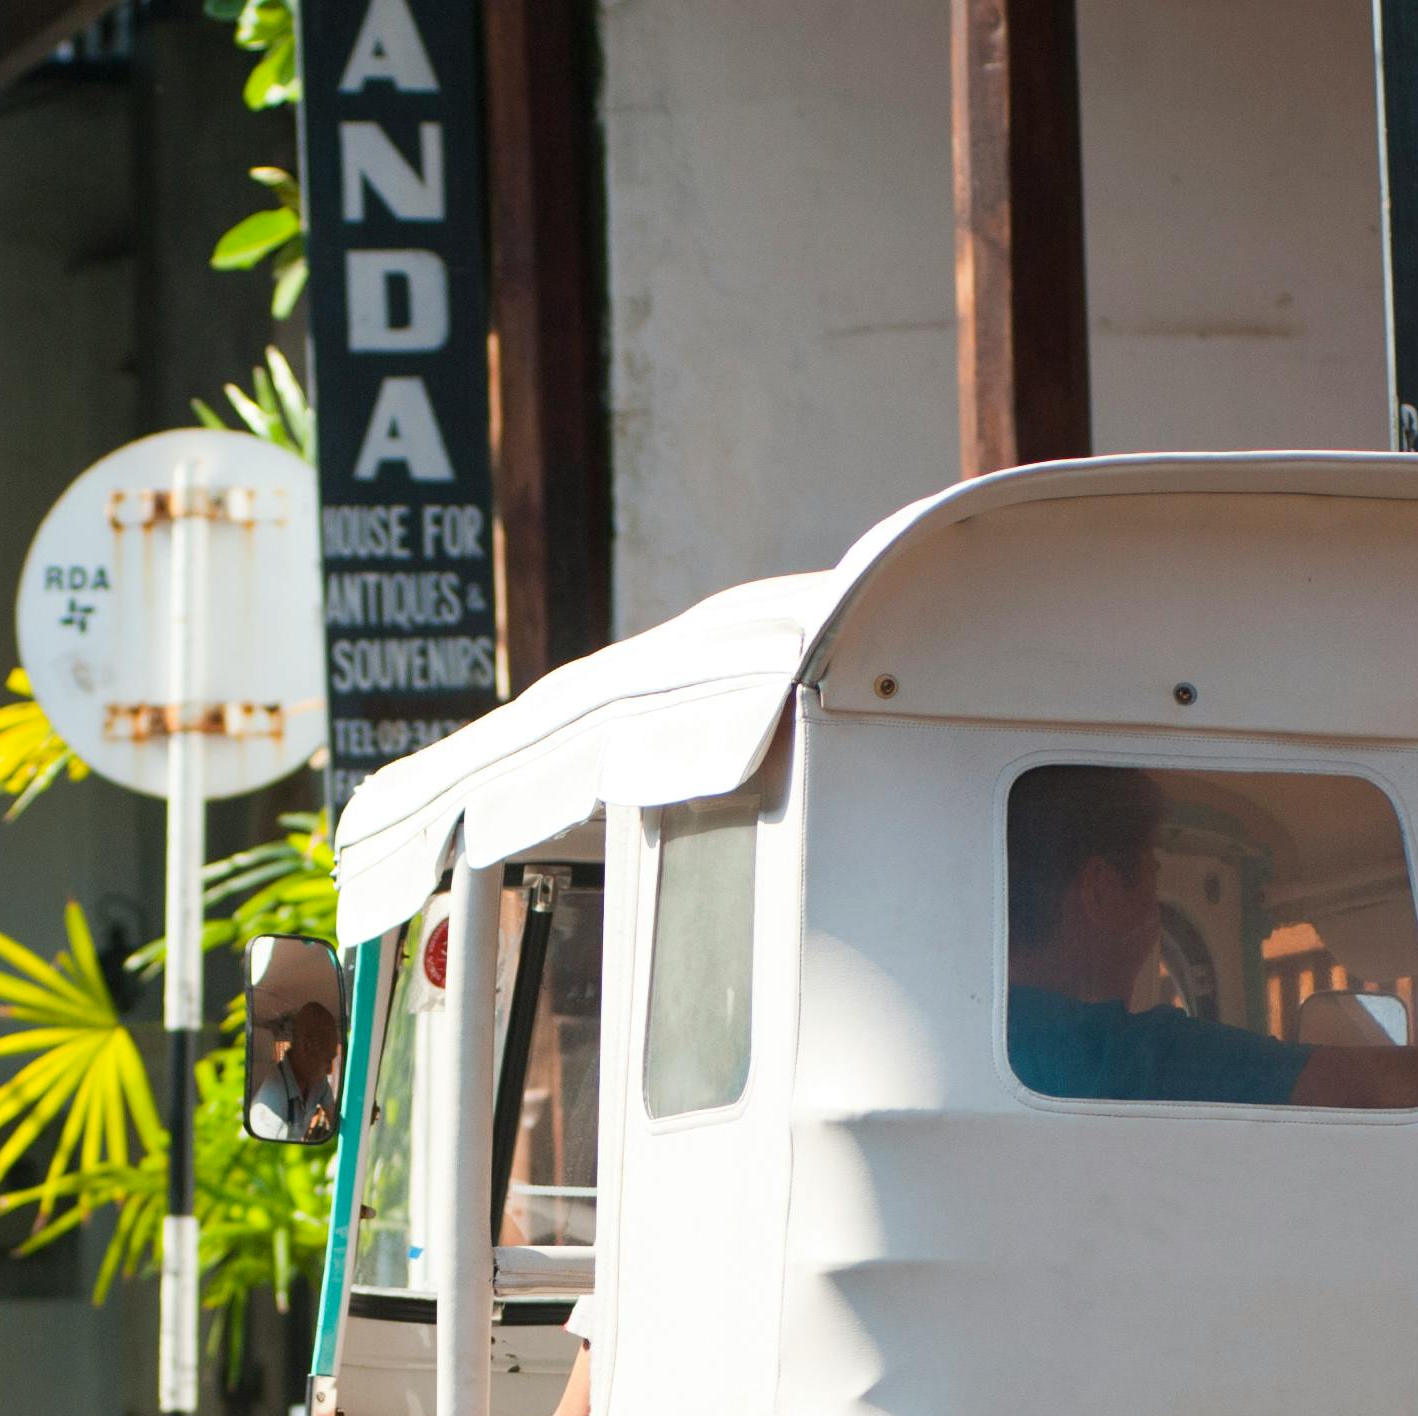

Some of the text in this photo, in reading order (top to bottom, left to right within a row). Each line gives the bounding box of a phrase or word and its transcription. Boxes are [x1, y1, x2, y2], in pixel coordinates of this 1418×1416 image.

[338, 0, 455, 481] ANDA
[423, 504, 485, 561] FOR
[44, 566, 112, 591] RDA
[325, 571, 461, 631] ANTIQUES
[332, 635, 496, 694] SOUVENIRS
